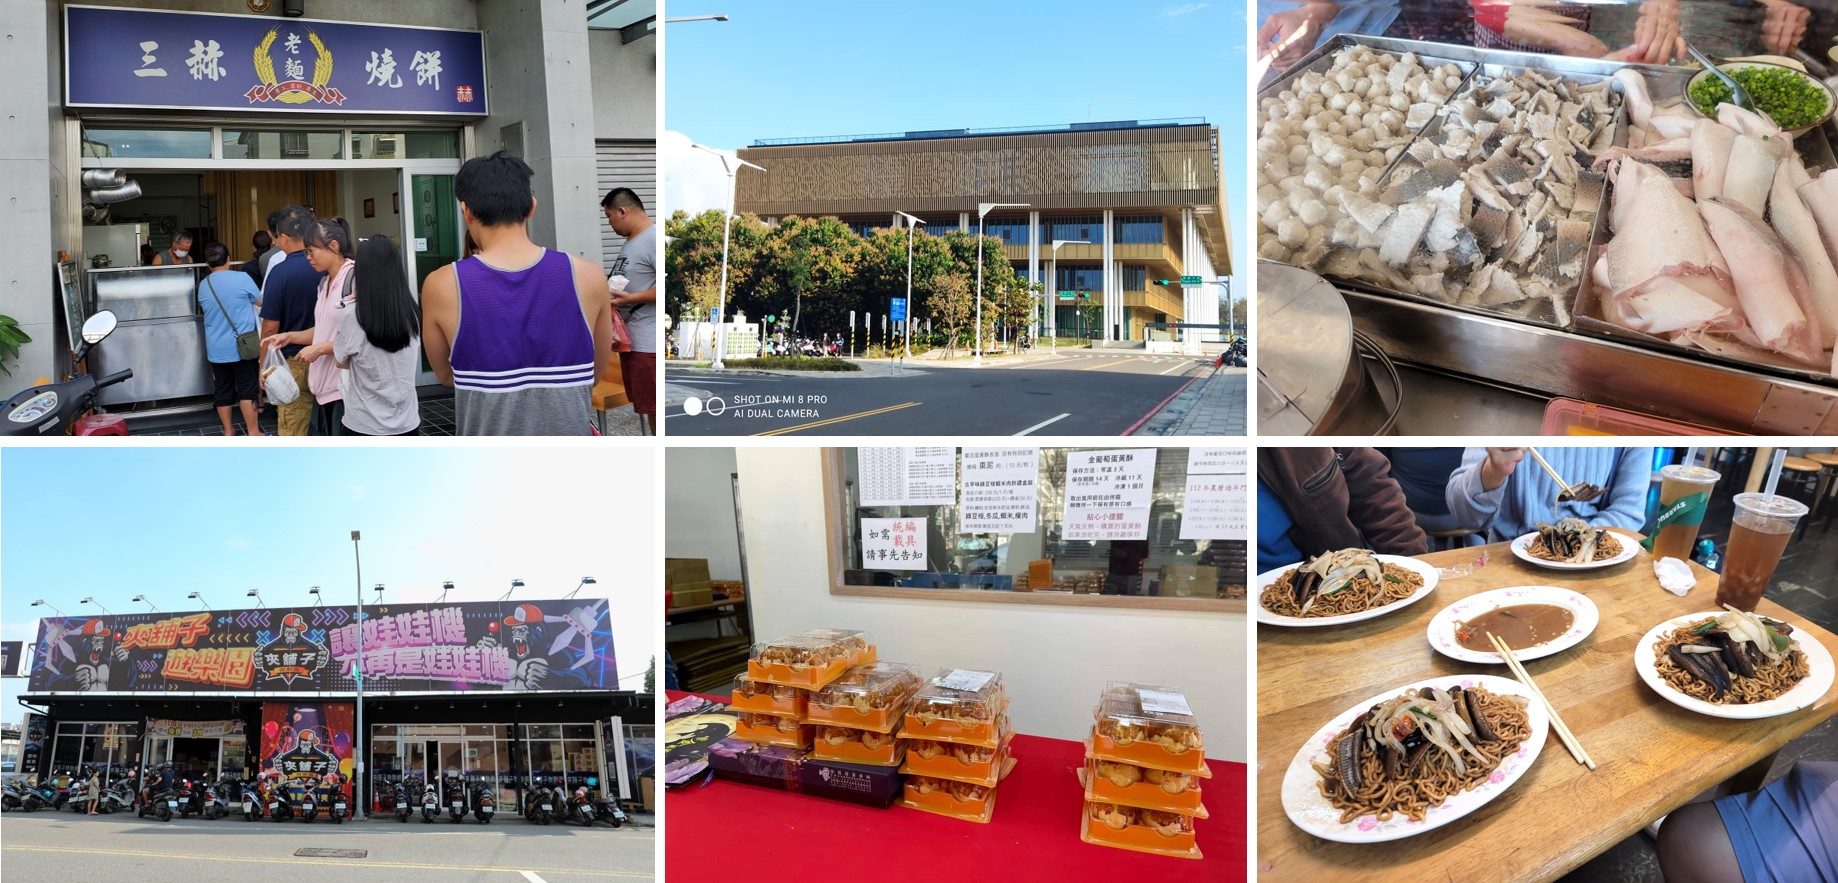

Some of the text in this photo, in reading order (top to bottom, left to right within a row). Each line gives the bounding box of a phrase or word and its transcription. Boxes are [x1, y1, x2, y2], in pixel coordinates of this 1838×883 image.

[133, 39, 227, 82] 三赫
[284, 32, 305, 80] 老麵
[365, 47, 443, 91] 燒餅
[866, 548, 922, 561] 請事先告知
[868, 528, 890, 540] 如需
[161, 646, 256, 688] 遊樂園
